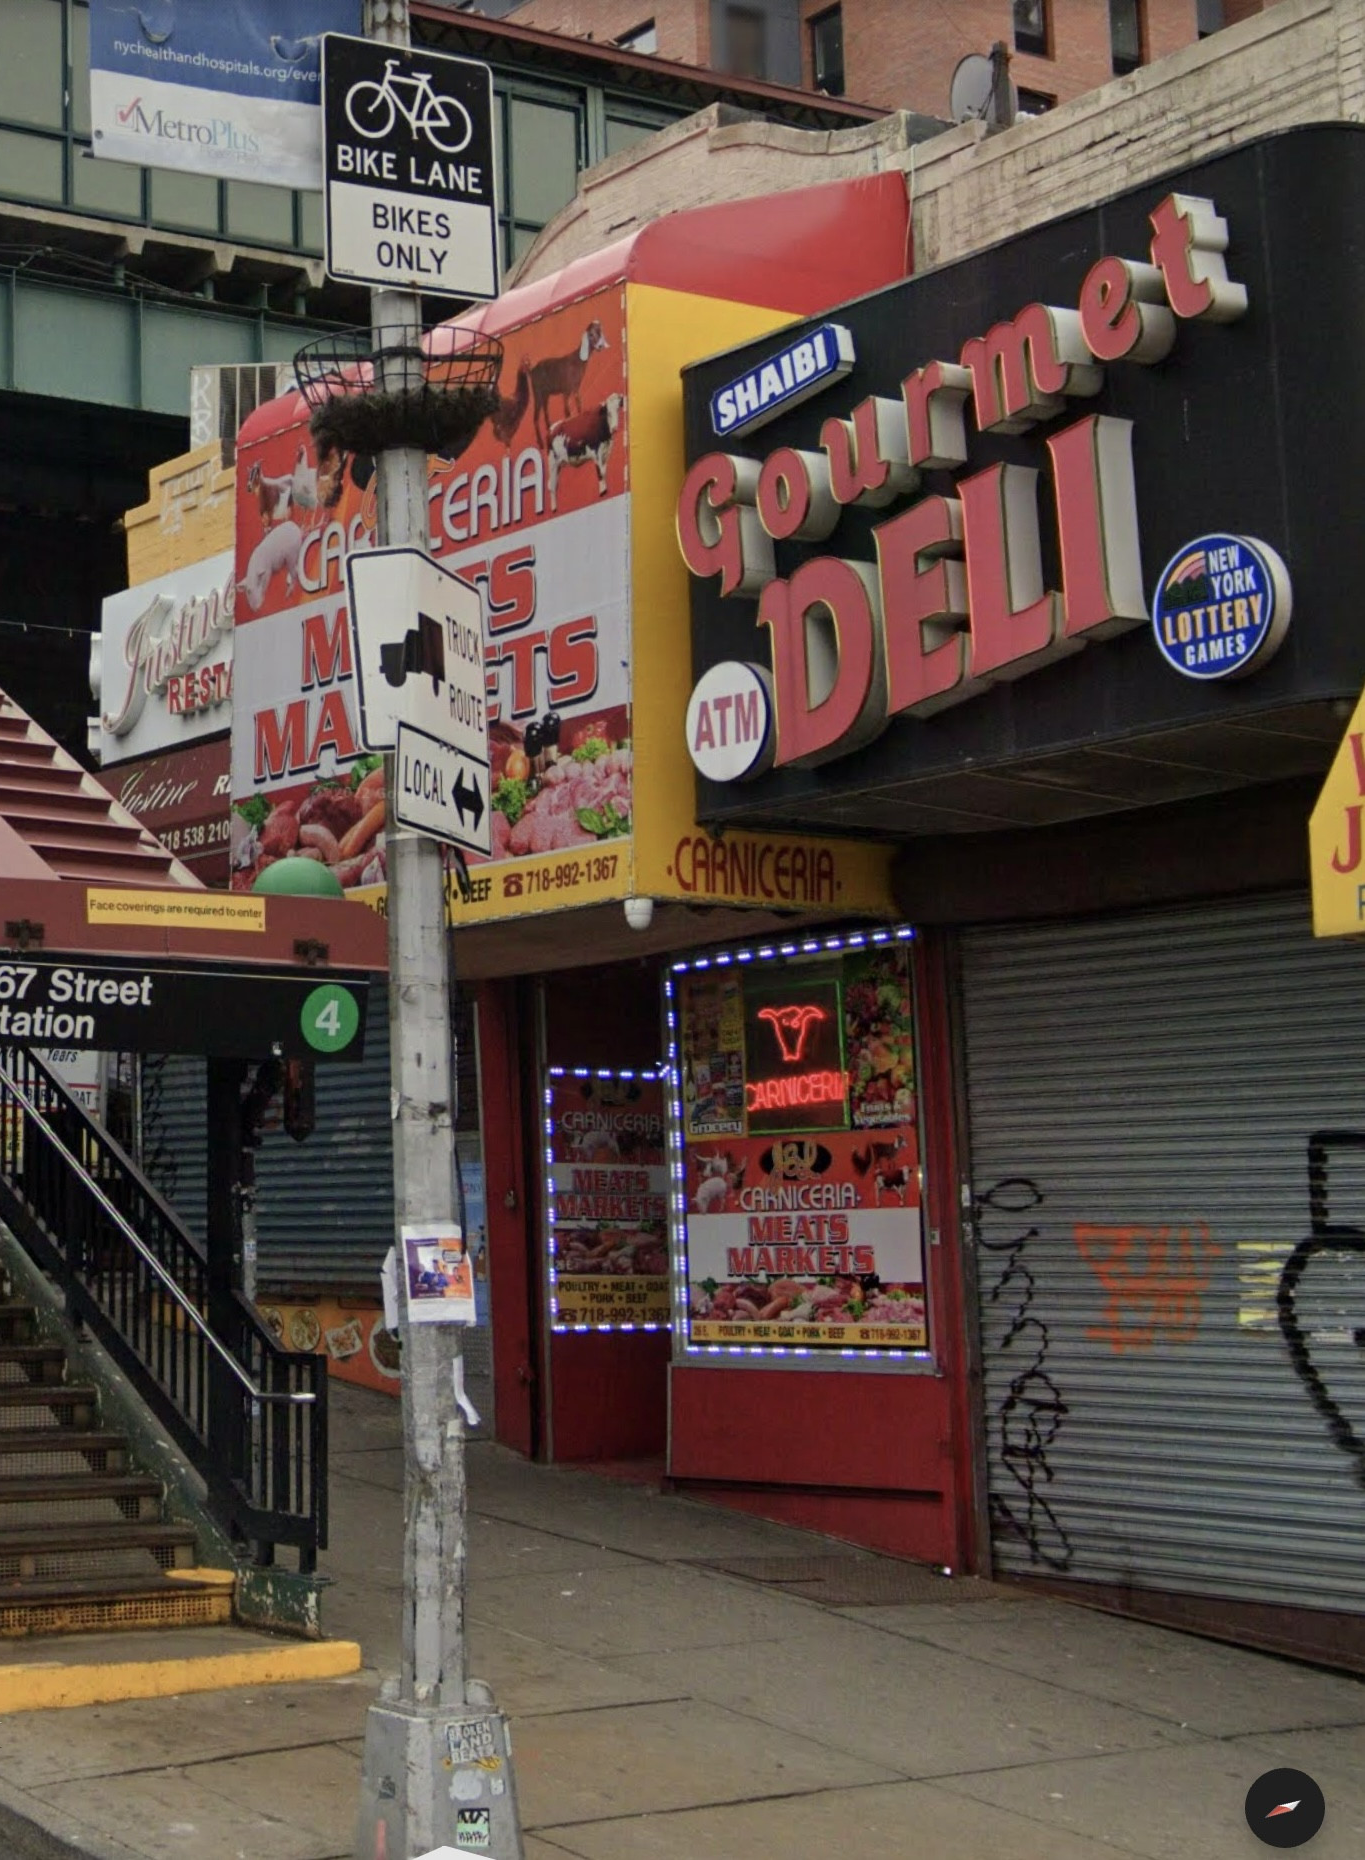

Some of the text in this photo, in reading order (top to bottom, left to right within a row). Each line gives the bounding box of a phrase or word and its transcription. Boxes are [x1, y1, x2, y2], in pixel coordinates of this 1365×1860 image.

[134, 104, 259, 151] MetroPlus
[337, 144, 482, 194] BIKE LANE
[373, 202, 451, 239] BIKES
[377, 241, 448, 275] ONLY
[677, 192, 1232, 598] Gourmet
[717, 333, 828, 428] SHAIBI
[1208, 545, 1240, 574] NEW
[756, 413, 1146, 768] DELI
[1211, 566, 1257, 600] YORK
[1164, 593, 1264, 646] LOTTERY
[445, 615, 481, 667] TRUCK
[1185, 633, 1246, 667] GAMES
[449, 683, 484, 732] ROUTE
[694, 689, 759, 752] ATM
[404, 755, 447, 807] LOCAL
[183, 825, 205, 848] 538
[526, 854, 619, 895] 718-992-1367
[674, 836, 834, 903] CARNICERIA
[89, 899, 262, 919] Face coverings are required to enter
[48, 967, 154, 1006] Street
[314, 1000, 341, 1037] 4
[690, 1119, 742, 1134] Grocery
[571, 1168, 650, 1193] MEATS
[739, 1182, 856, 1211] CARNICERIA
[555, 1194, 668, 1220] MARKETS
[748, 1213, 850, 1245] MEATS
[726, 1245, 876, 1277] MARKETS
[558, 1281, 599, 1293] POULTRY
[589, 1293, 615, 1304] PORK
[718, 1325, 745, 1337] POULTRY
[828, 1327, 845, 1339] BEEF
